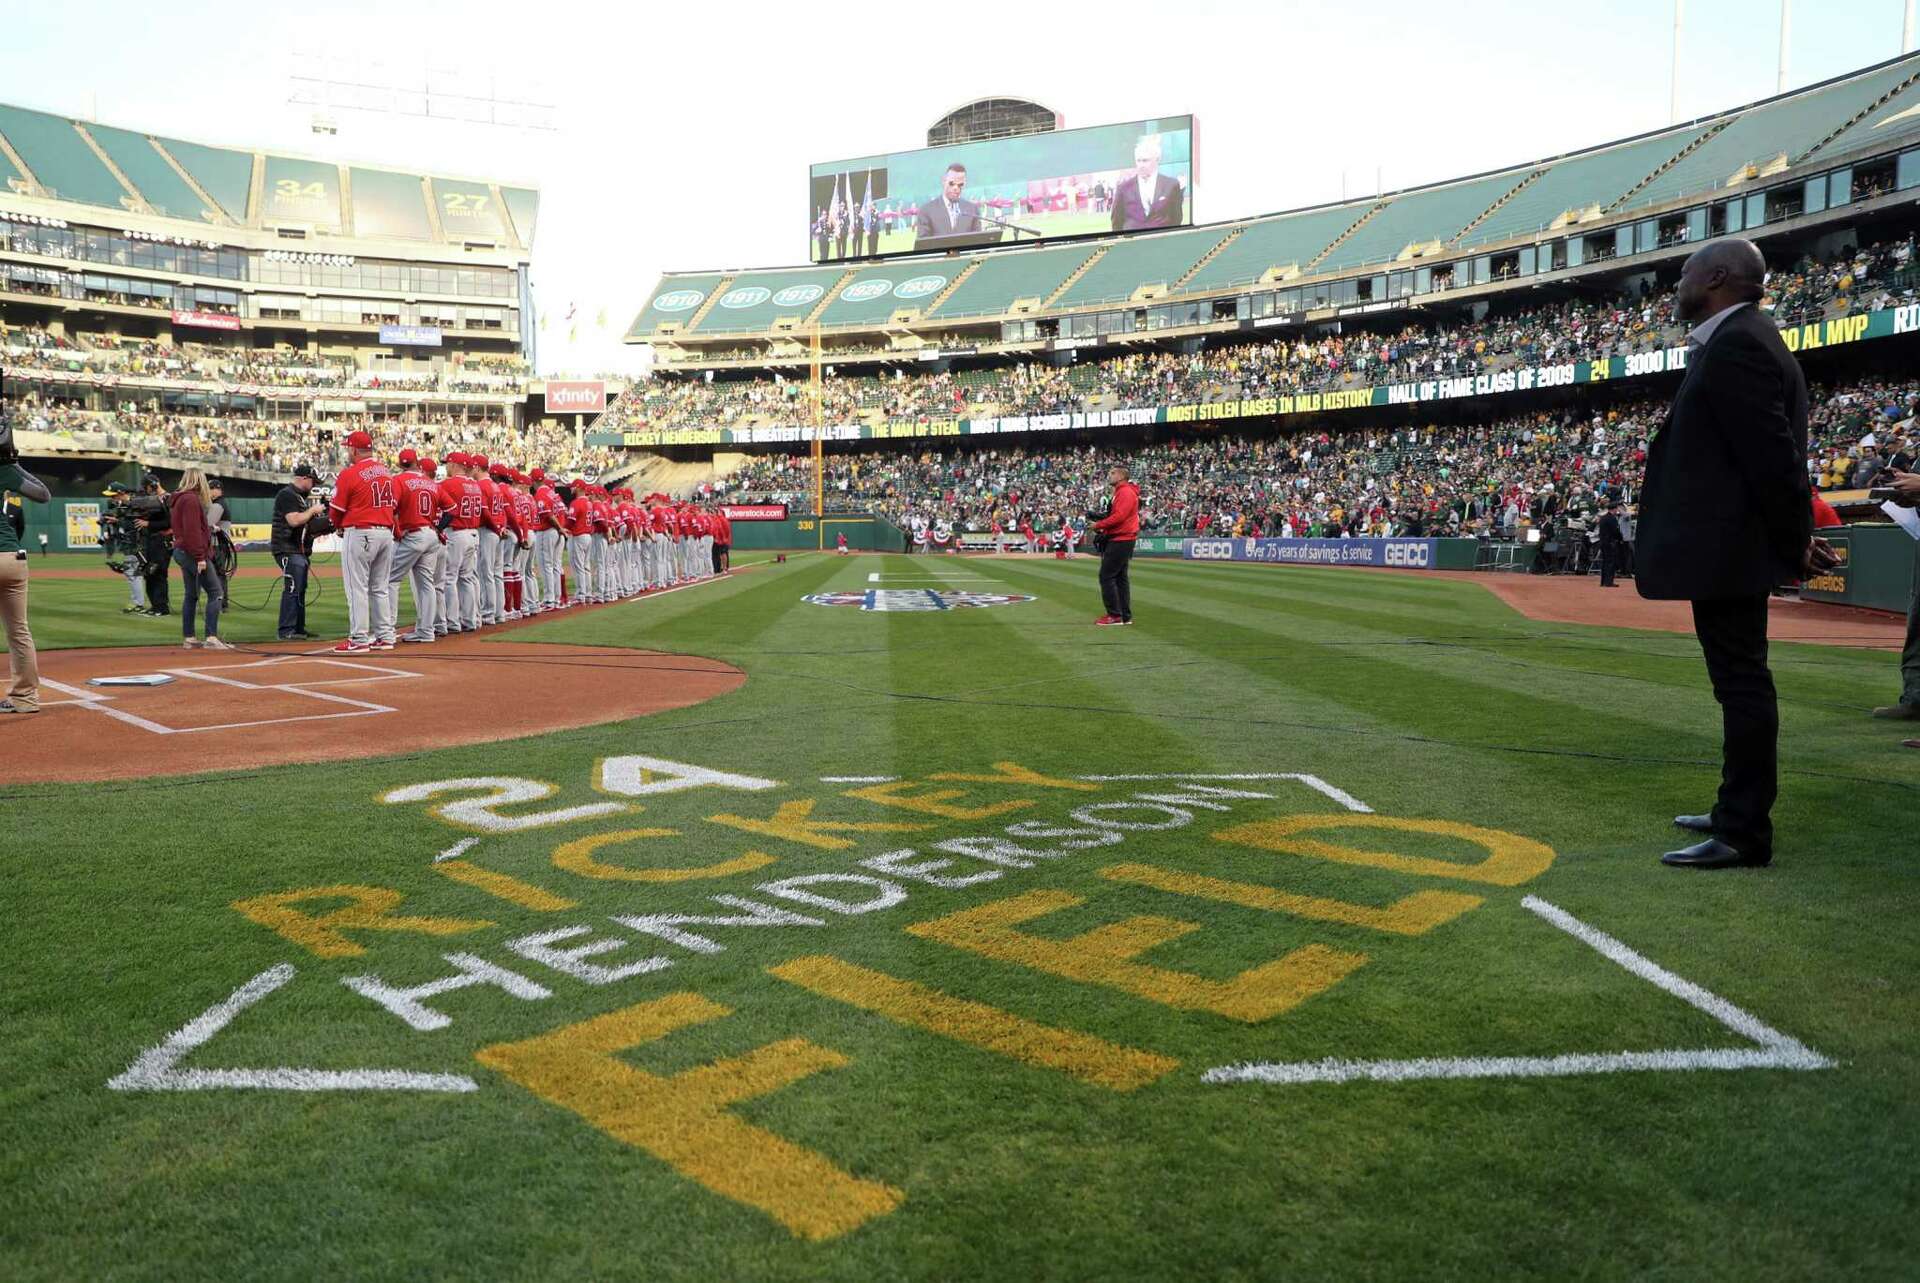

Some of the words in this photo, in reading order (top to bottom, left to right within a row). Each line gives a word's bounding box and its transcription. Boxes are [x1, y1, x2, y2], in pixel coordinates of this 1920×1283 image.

[275, 179, 327, 199] 34
[443, 192, 489, 209] 27
[727, 291, 766, 305] 1911
[780, 289, 820, 302] 1913
[848, 283, 890, 297] 1929
[900, 280, 941, 293] 1930
[660, 294, 699, 307] 1910
[1894, 303, 1920, 334] RI
[1802, 322, 1823, 350] AL
[1826, 314, 1868, 346] MVP
[1590, 358, 1610, 381] 24
[1624, 350, 1664, 376] 3000
[1388, 383, 1418, 404] HALL
[1420, 381, 1437, 401] OF
[1438, 377, 1473, 399] FAME
[1476, 371, 1516, 395] CLASS
[1518, 369, 1536, 390] OF
[1538, 364, 1575, 387] 2009
[552, 387, 600, 405] xfinity
[1166, 405, 1198, 422] MOST
[1200, 401, 1239, 420] STOLEN
[1241, 398, 1277, 416] BASES
[1279, 395, 1295, 414] IN
[1296, 393, 1321, 412] MLB
[1323, 388, 1373, 409] HISTORY
[871, 424, 889, 438] THE
[890, 423, 914, 437] MAN
[916, 422, 929, 437] OF
[930, 420, 960, 436] STEAL
[970, 419, 999, 434] MOST
[1000, 416, 1028, 433] RUNS
[1029, 414, 1070, 432] SCORED
[1071, 412, 1085, 429] IN
[1086, 411, 1109, 428] MLB
[1111, 407, 1158, 426] HISTORY
[624, 432, 661, 446] RICKEY
[662, 430, 720, 445] HENDERSON
[732, 429, 751, 443] THE
[752, 427, 799, 442] GREATEST
[801, 427, 816, 441] OF
[370, 480, 393, 508] 14
[418, 490, 432, 516] 0
[460, 495, 481, 518] 25
[730, 508, 783, 518] overstock.com
[798, 520, 814, 531] 330
[1191, 542, 1233, 559] GEICO
[1246, 540, 1264, 558] Over
[1267, 543, 1277, 558] 75
[1277, 545, 1297, 560] years
[1299, 543, 1308, 558] of
[1308, 545, 1340, 563] savings
[1342, 544, 1349, 560] &
[1350, 546, 1373, 560] service
[1384, 542, 1429, 566] GEICO
[378, 754, 788, 832] 24
[231, 761, 1097, 959] RICKEY
[342, 781, 1278, 1033] HENDERSON
[473, 813, 1556, 1240] FIELD
